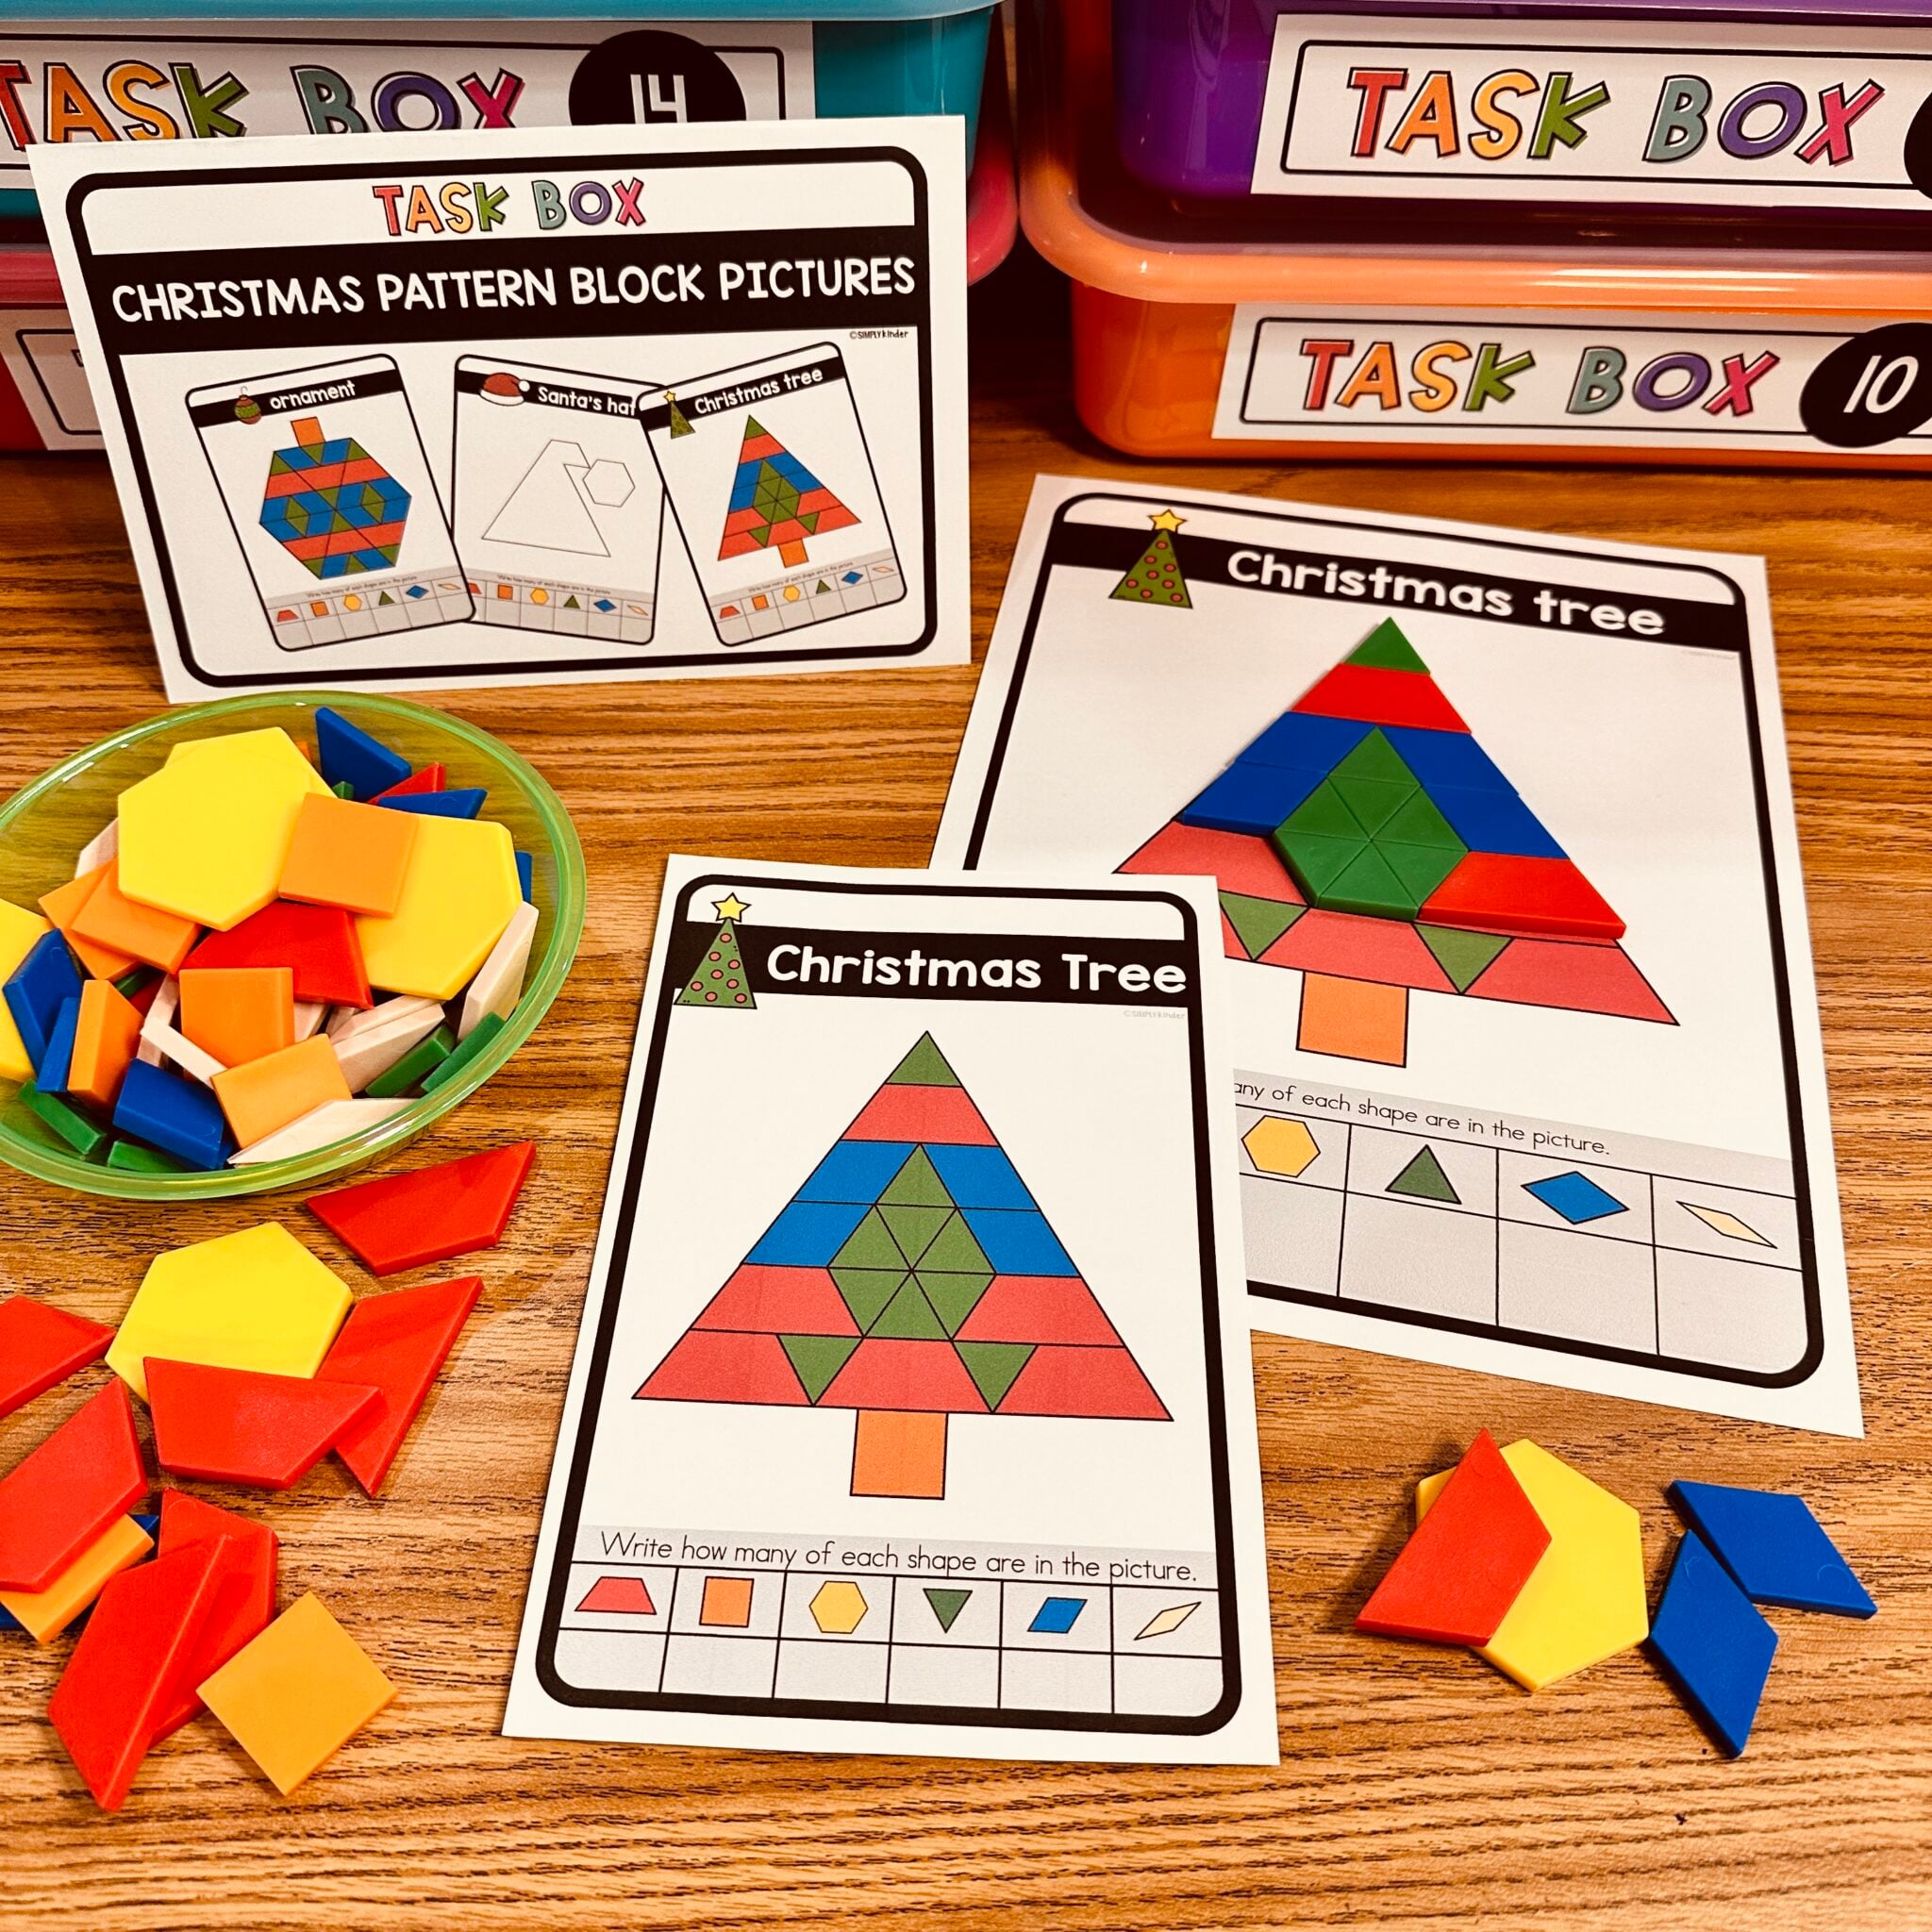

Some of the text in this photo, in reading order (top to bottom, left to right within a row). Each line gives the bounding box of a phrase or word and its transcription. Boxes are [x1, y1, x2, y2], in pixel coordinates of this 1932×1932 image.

[0, 59, 688, 152] TASK BOX 14
[1347, 67, 1886, 167] TASK BOX
[372, 176, 646, 236] TASK BOX
[111, 257, 916, 323] CHRISTMAS PATTERN BLOCK PICTURES
[270, 379, 357, 410] ornament
[538, 386, 603, 411] Santa's
[694, 369, 824, 415] Christmas tree
[1299, 339, 1920, 418] TASK BOX 10
[1227, 550, 1666, 637] Christmas tree
[767, 943, 1187, 993] Christmas Tree
[1233, 1080, 1611, 1157] any of each shape are in the picture.
[601, 1530, 1198, 1584] Write how many of each shape are in the picture.
